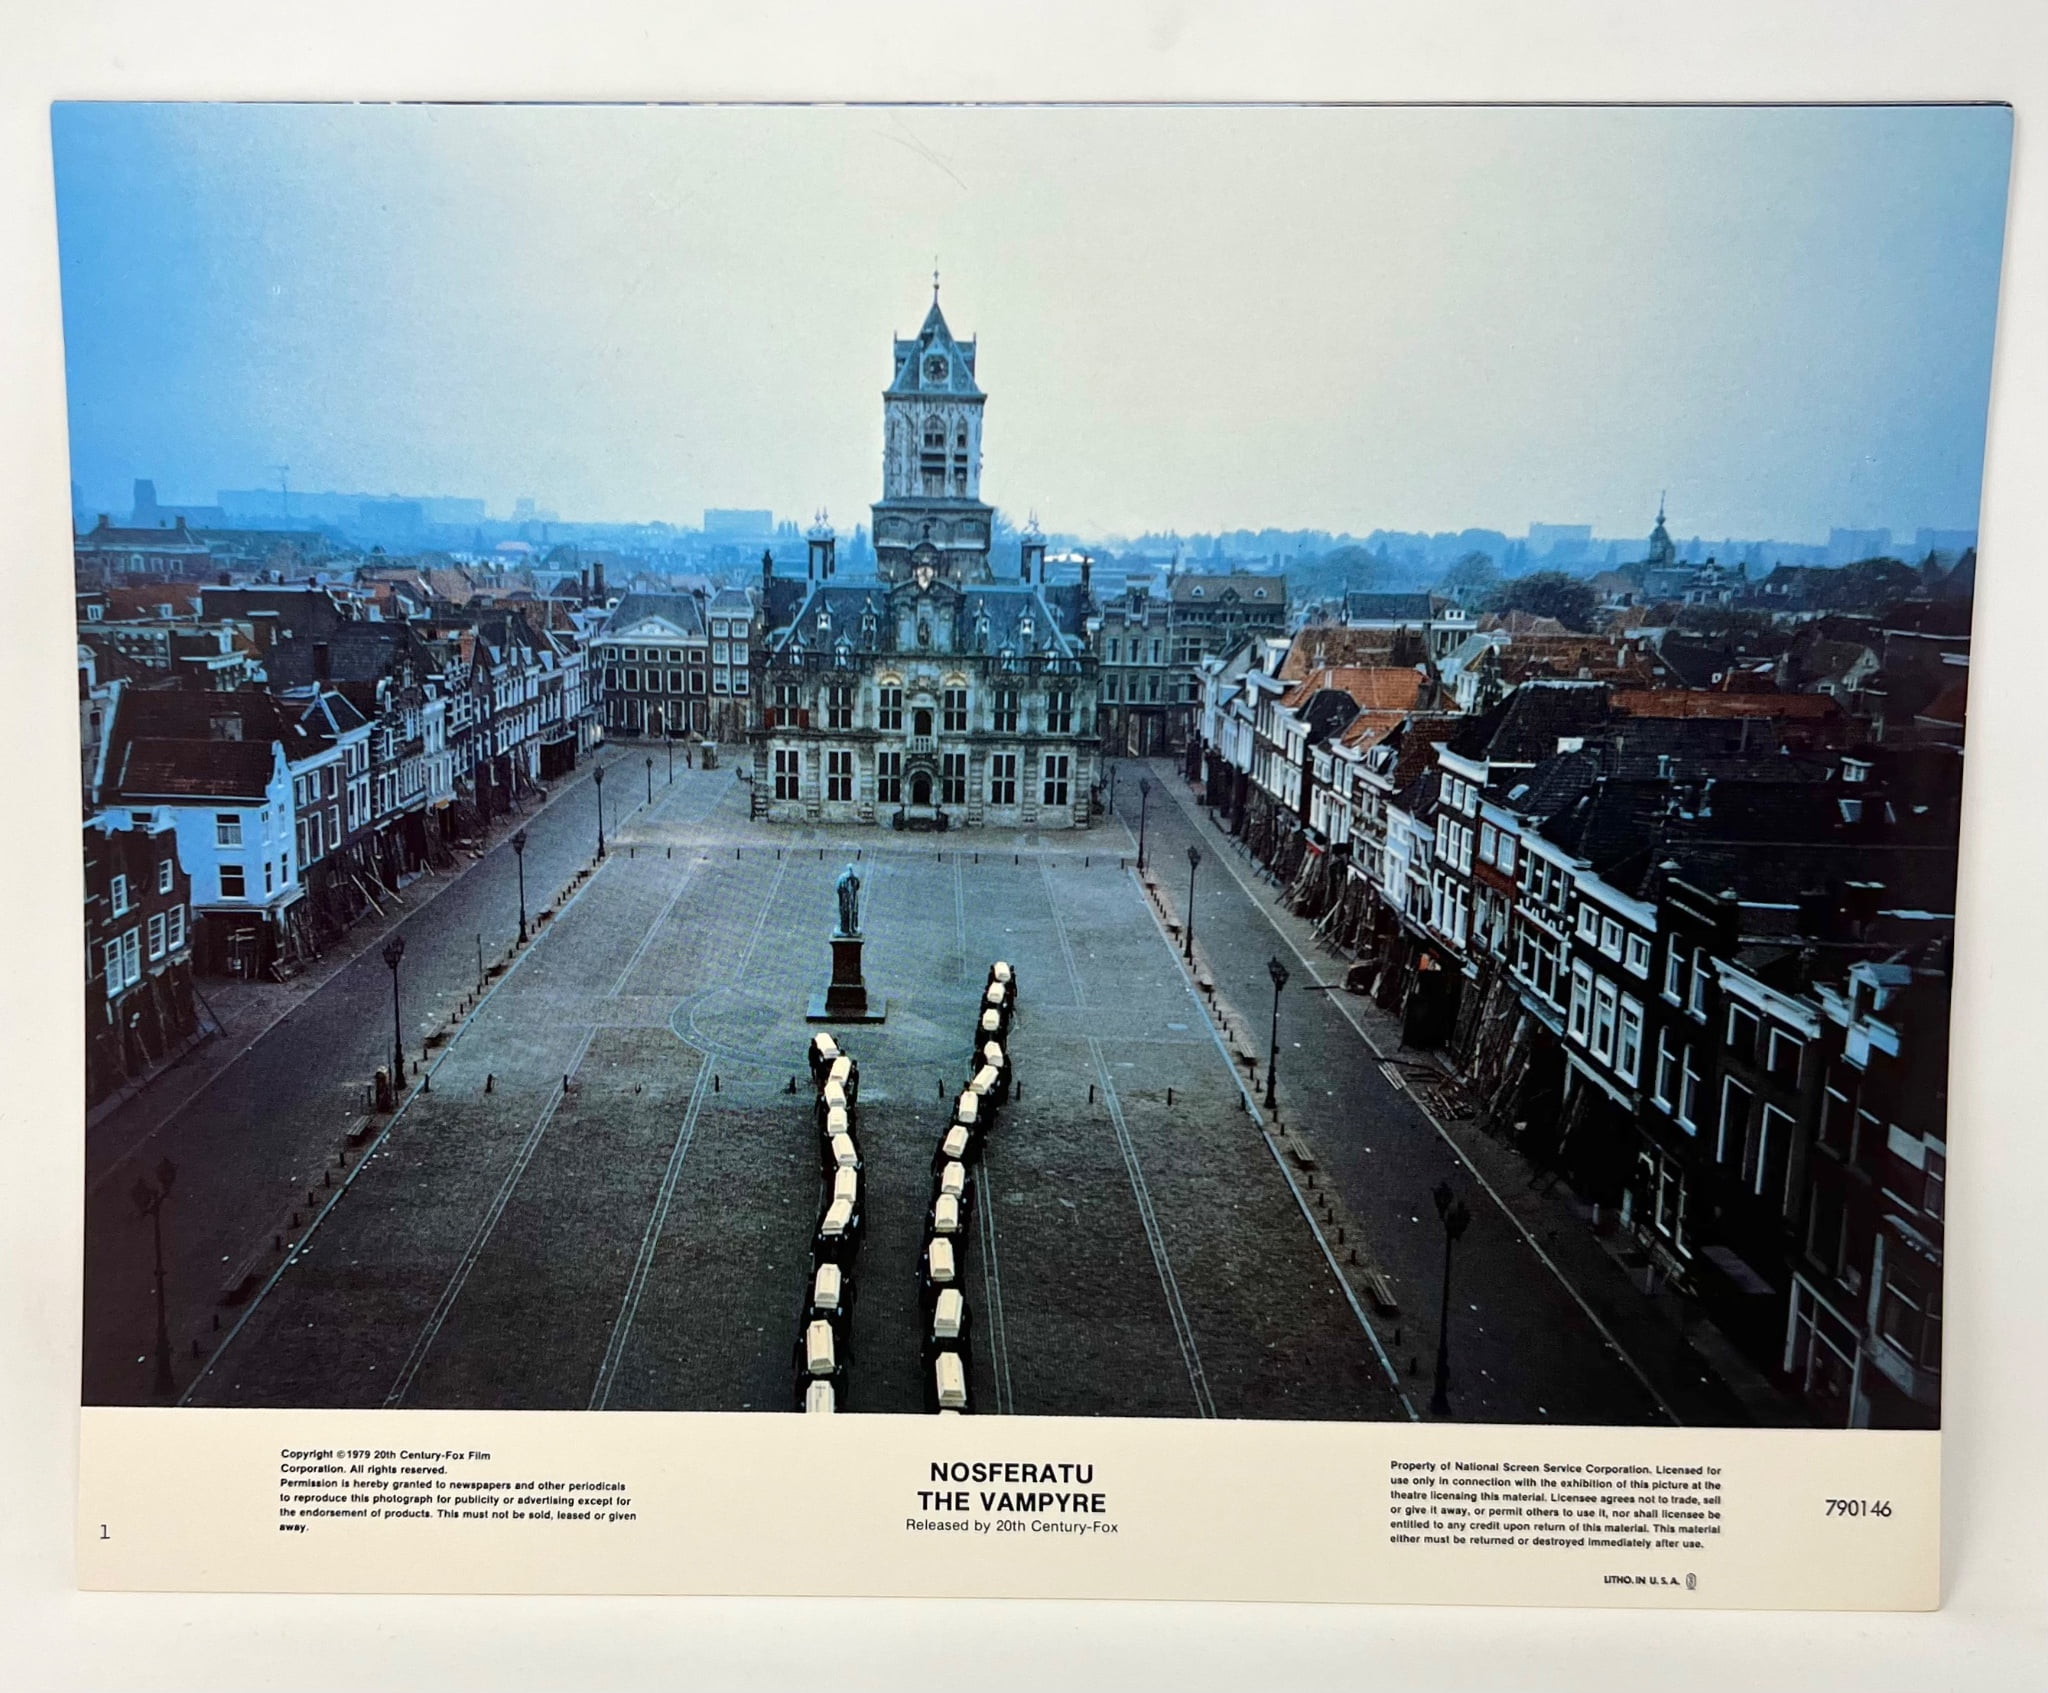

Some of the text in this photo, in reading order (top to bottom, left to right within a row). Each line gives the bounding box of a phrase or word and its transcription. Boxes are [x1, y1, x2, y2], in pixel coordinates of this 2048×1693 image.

[280, 1448, 334, 1461] Copyright
[373, 1449, 396, 1460] 20th
[399, 1449, 465, 1463] Century-Fox
[468, 1450, 491, 1461] Film
[280, 1463, 448, 1476] Corporation. All rights reserved.
[930, 1461, 1093, 1484] NOSFERATU
[1390, 1460, 1722, 1476] Property of National Screen Service Corporation. Licensed for
[280, 1478, 626, 1493] Permission is hereby granted to newspapers and other periodicals
[1390, 1476, 1722, 1491] use only in connection with the exhibition of this picture at the
[280, 1493, 632, 1508] to reproduce this photograph for publicity or advertising except for
[916, 1491, 1106, 1513] THE VAMPYRE
[1390, 1490, 1722, 1506] theatre licensing this material. Licensee agrees not to trade, sell
[279, 1507, 637, 1523] the endorsement of products. This must not be sold, leased or given
[1390, 1505, 1722, 1520] or give it away, or permit others to use it, nor shall licensee be
[1825, 1499, 1892, 1517] 790146
[100, 1524, 111, 1540] 1
[279, 1524, 309, 1534] away.
[906, 1518, 1118, 1536] Released by 20th Century-Fox
[1390, 1519, 1721, 1534] entitled to any credit upon return of this material. This material
[1390, 1534, 1704, 1550] either must be returned or destroyed immediately after use.
